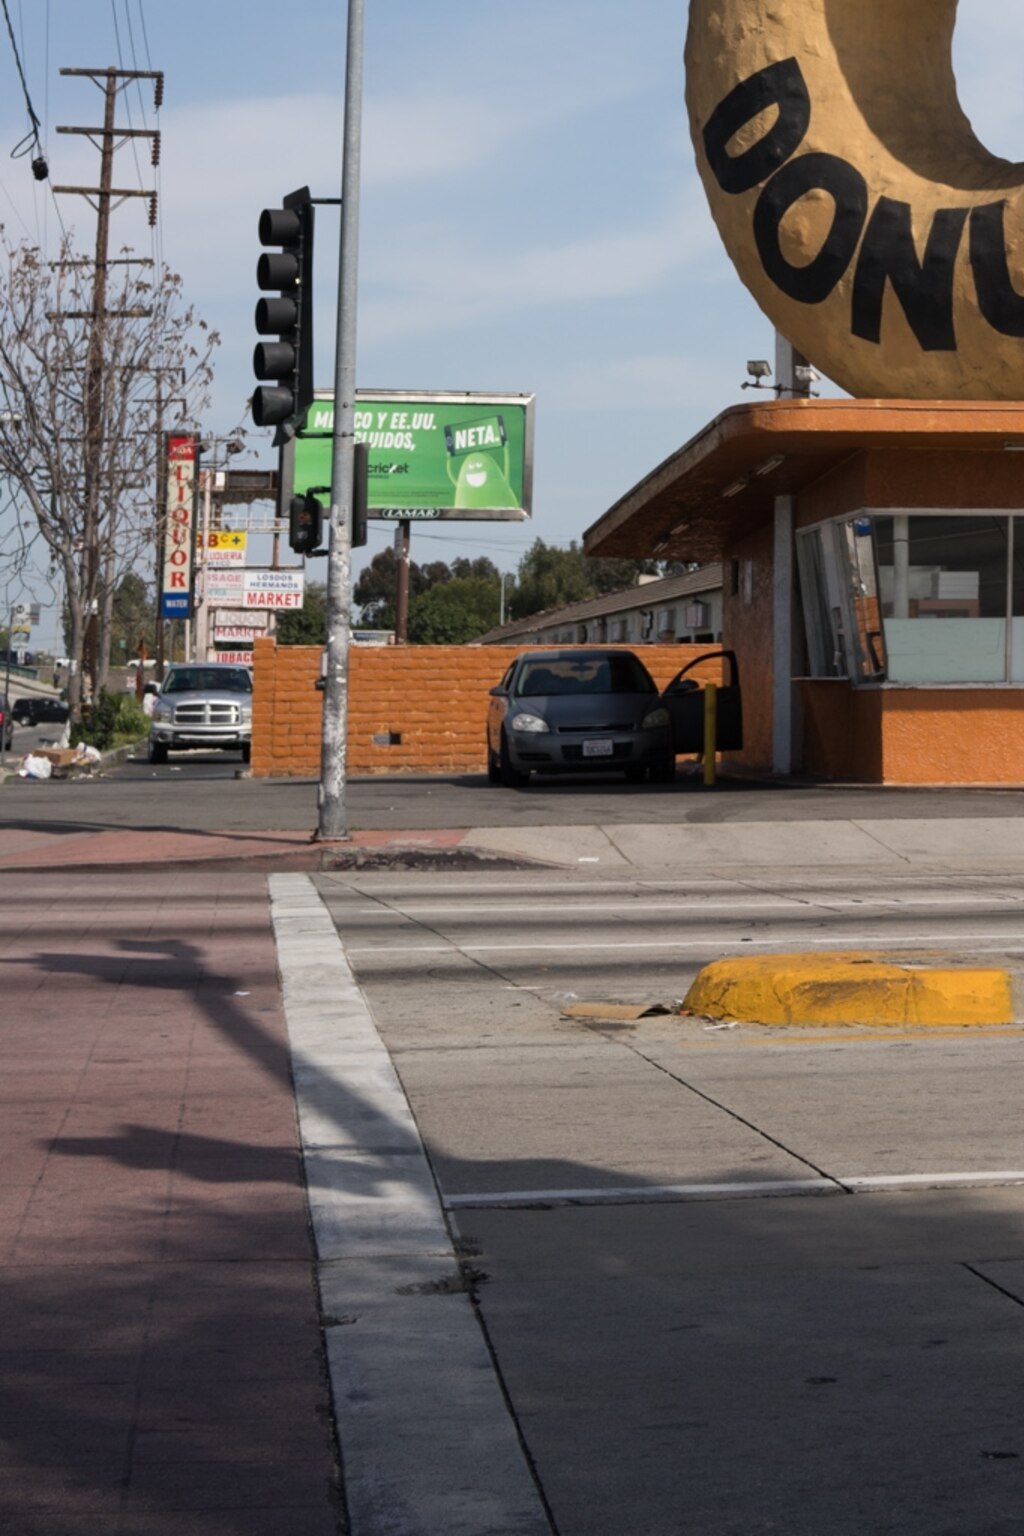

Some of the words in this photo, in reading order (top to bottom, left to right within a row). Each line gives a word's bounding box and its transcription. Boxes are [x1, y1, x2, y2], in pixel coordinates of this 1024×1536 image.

[377, 411, 388, 430] Y
[390, 412, 437, 431] EE.UU.
[353, 431, 417, 451] CLUIDOS,
[455, 424, 500, 449] NETA.
[366, 461, 409, 474] cricket
[387, 508, 434, 518] LAMAR
[170, 464, 189, 587] LIQUOR
[249, 581, 299, 589] HERMANOS
[246, 591, 301, 607] MARKET
[217, 612, 266, 626] LIQUOR
